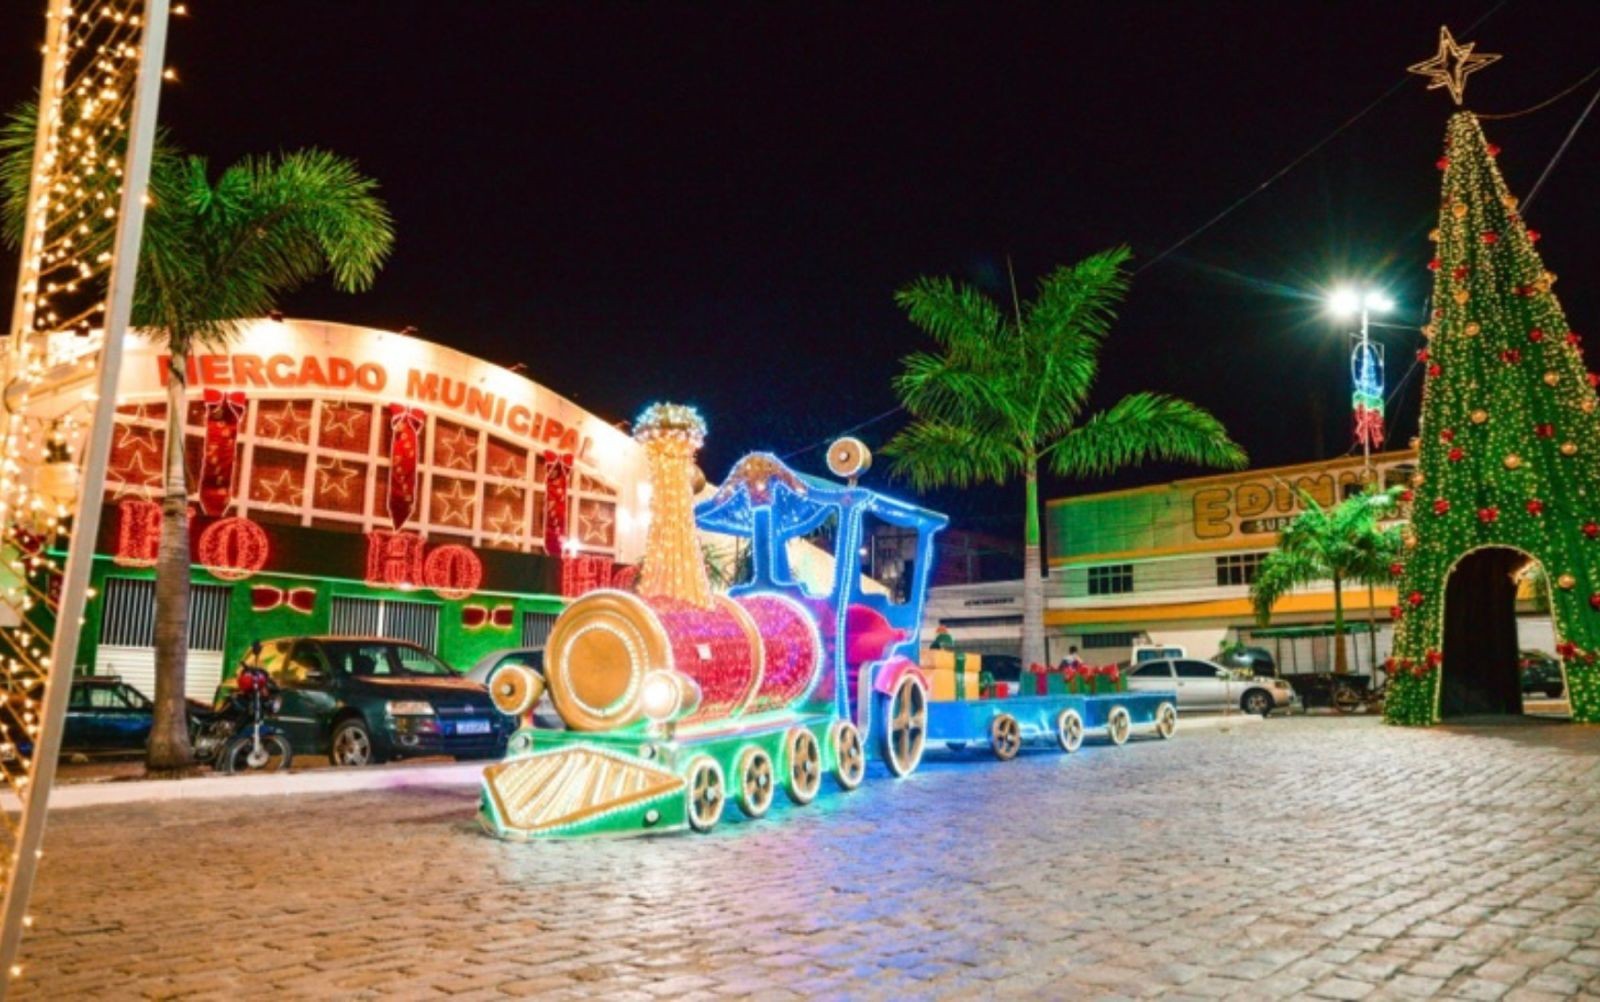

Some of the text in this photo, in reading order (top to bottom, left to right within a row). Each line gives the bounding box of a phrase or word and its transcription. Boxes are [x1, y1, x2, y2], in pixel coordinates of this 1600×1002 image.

[157, 354, 598, 466] MERCADO MUNICIPAL
[365, 528, 483, 600] HO
